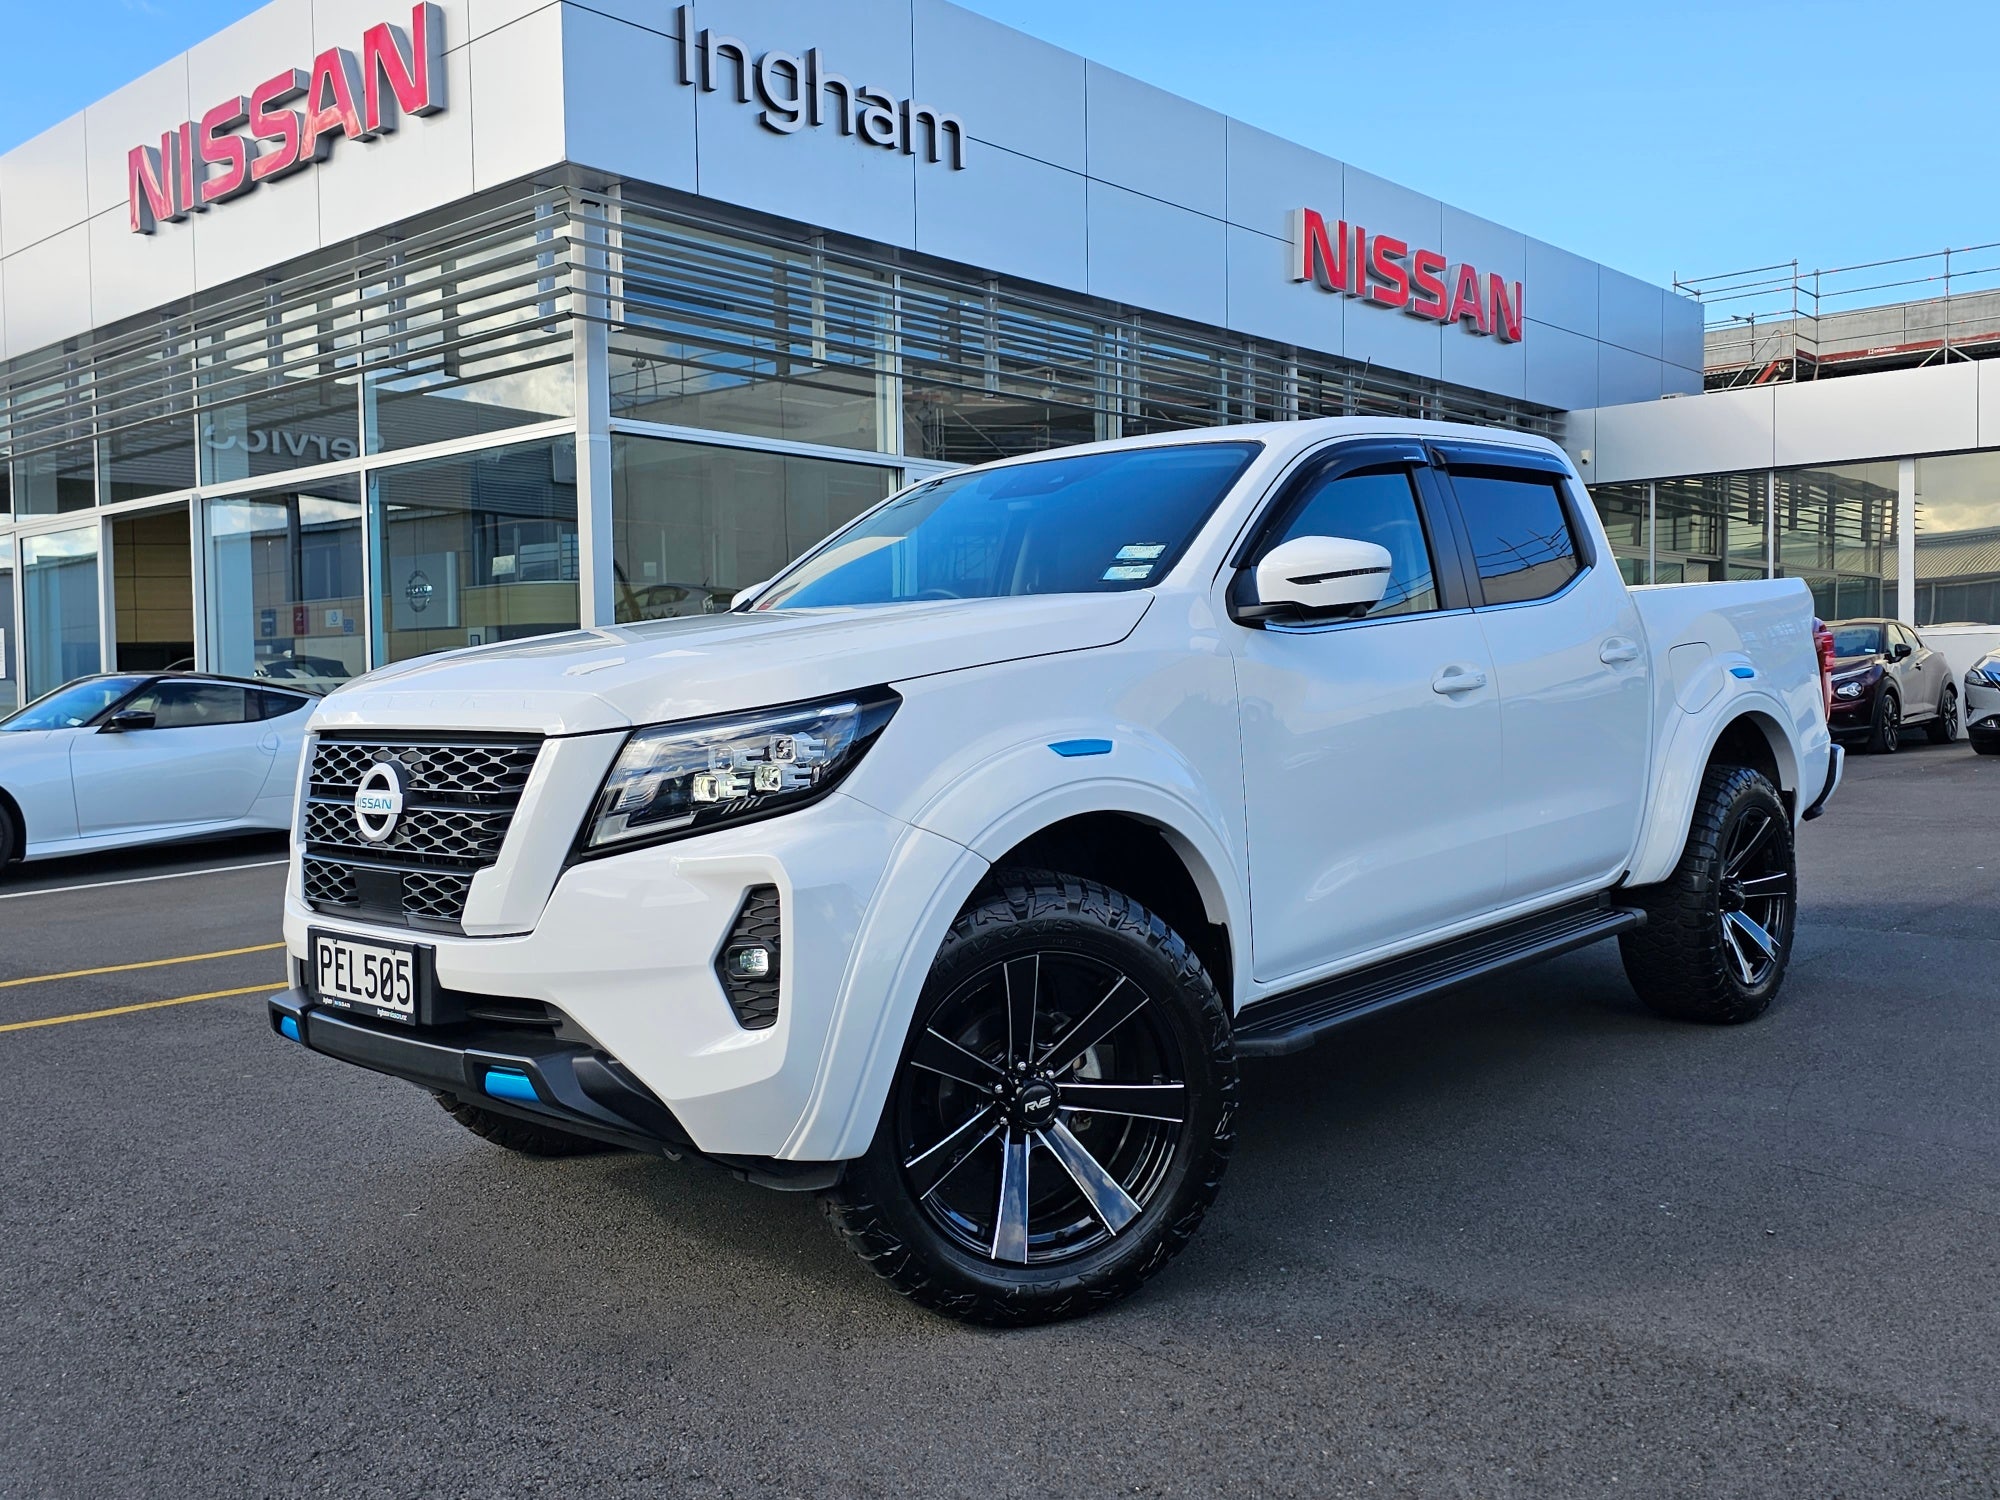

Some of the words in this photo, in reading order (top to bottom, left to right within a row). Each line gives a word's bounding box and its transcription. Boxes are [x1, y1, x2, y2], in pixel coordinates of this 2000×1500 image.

[128, 1, 438, 234] NISSAN
[678, 4, 967, 170] Ingham
[1297, 207, 1522, 344] NISSAN
[319, 944, 411, 1006] PEL505
